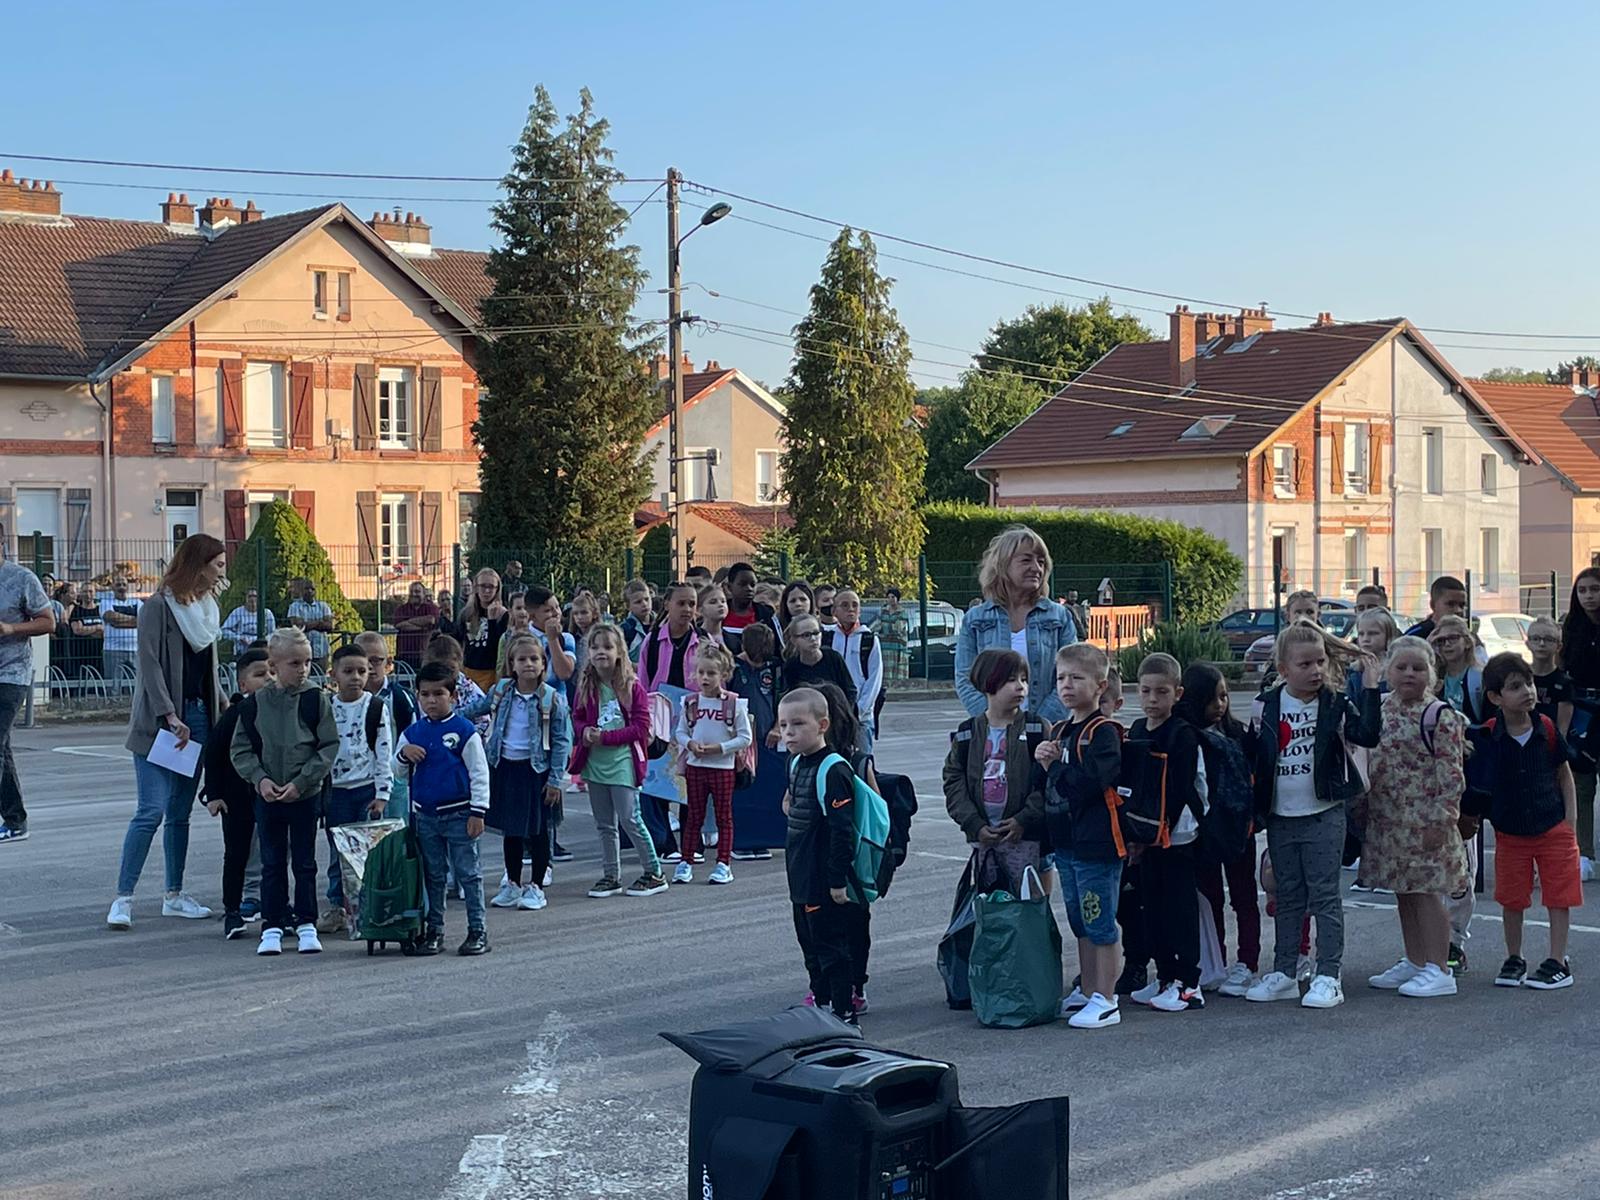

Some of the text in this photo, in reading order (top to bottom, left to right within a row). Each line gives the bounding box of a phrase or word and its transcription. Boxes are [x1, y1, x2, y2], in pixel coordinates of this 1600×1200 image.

[697, 709, 724, 720] OVE
[1283, 744, 1313, 757] LOV
[1277, 763, 1311, 776] IBES
